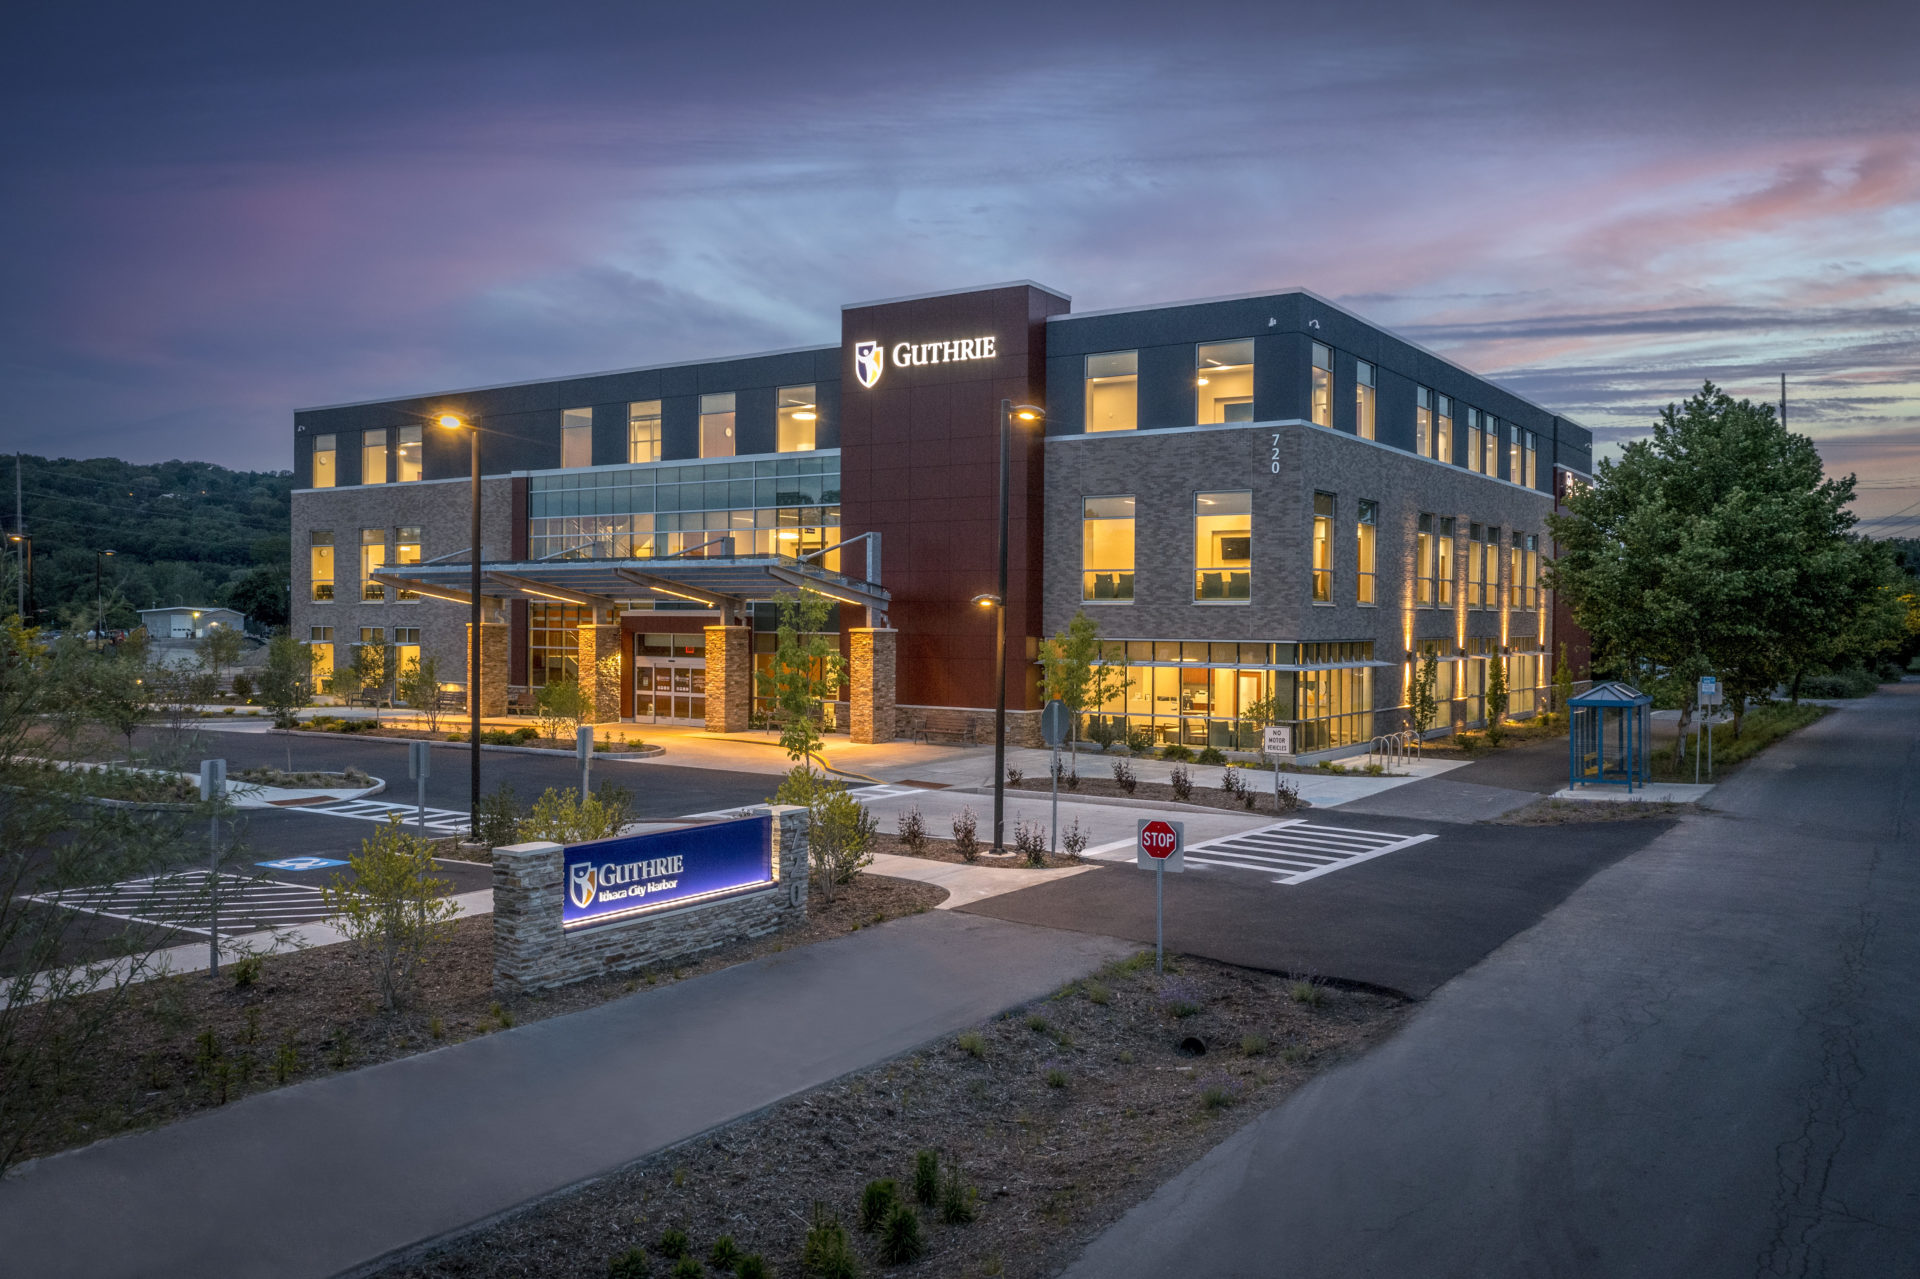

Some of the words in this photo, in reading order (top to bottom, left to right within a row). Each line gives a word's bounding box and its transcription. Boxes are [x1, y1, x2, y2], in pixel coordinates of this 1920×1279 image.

[892, 336, 996, 368] GUTHRIE
[1271, 433, 1280, 474] 720
[1143, 831, 1175, 848] STOP
[599, 854, 684, 887] GUTHRIE
[599, 887, 628, 903] Ithaca
[628, 884, 647, 897] City
[647, 878, 679, 893] Harbor
